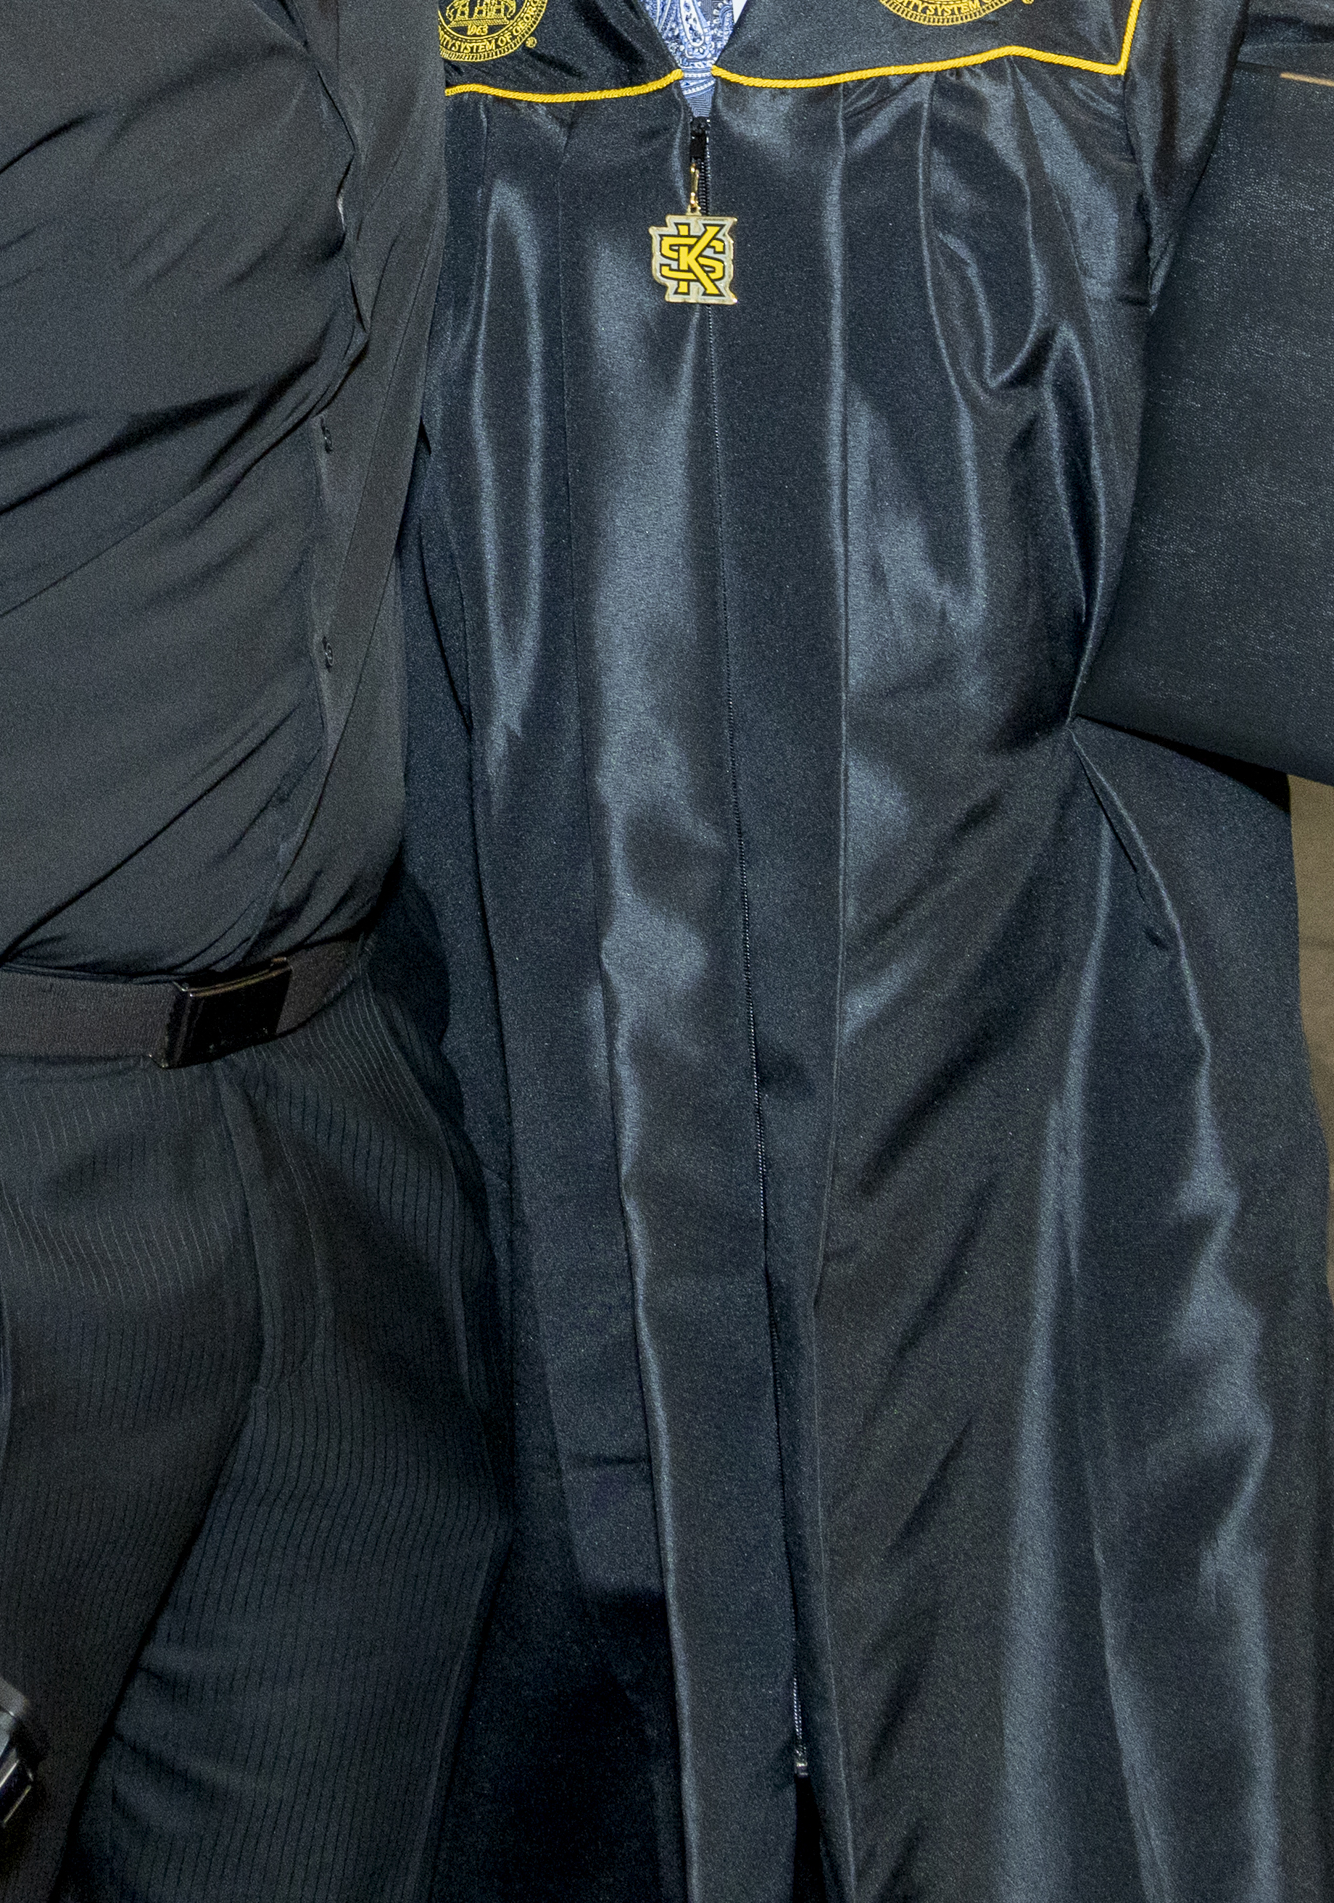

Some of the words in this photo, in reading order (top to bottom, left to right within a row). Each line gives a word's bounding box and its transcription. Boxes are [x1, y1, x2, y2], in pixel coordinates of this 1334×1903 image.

[926, 0, 980, 16] SYSTEM
[467, 25, 488, 35] 1963
[454, 40, 495, 52] SYSTEM
[498, 34, 512, 47] OF
